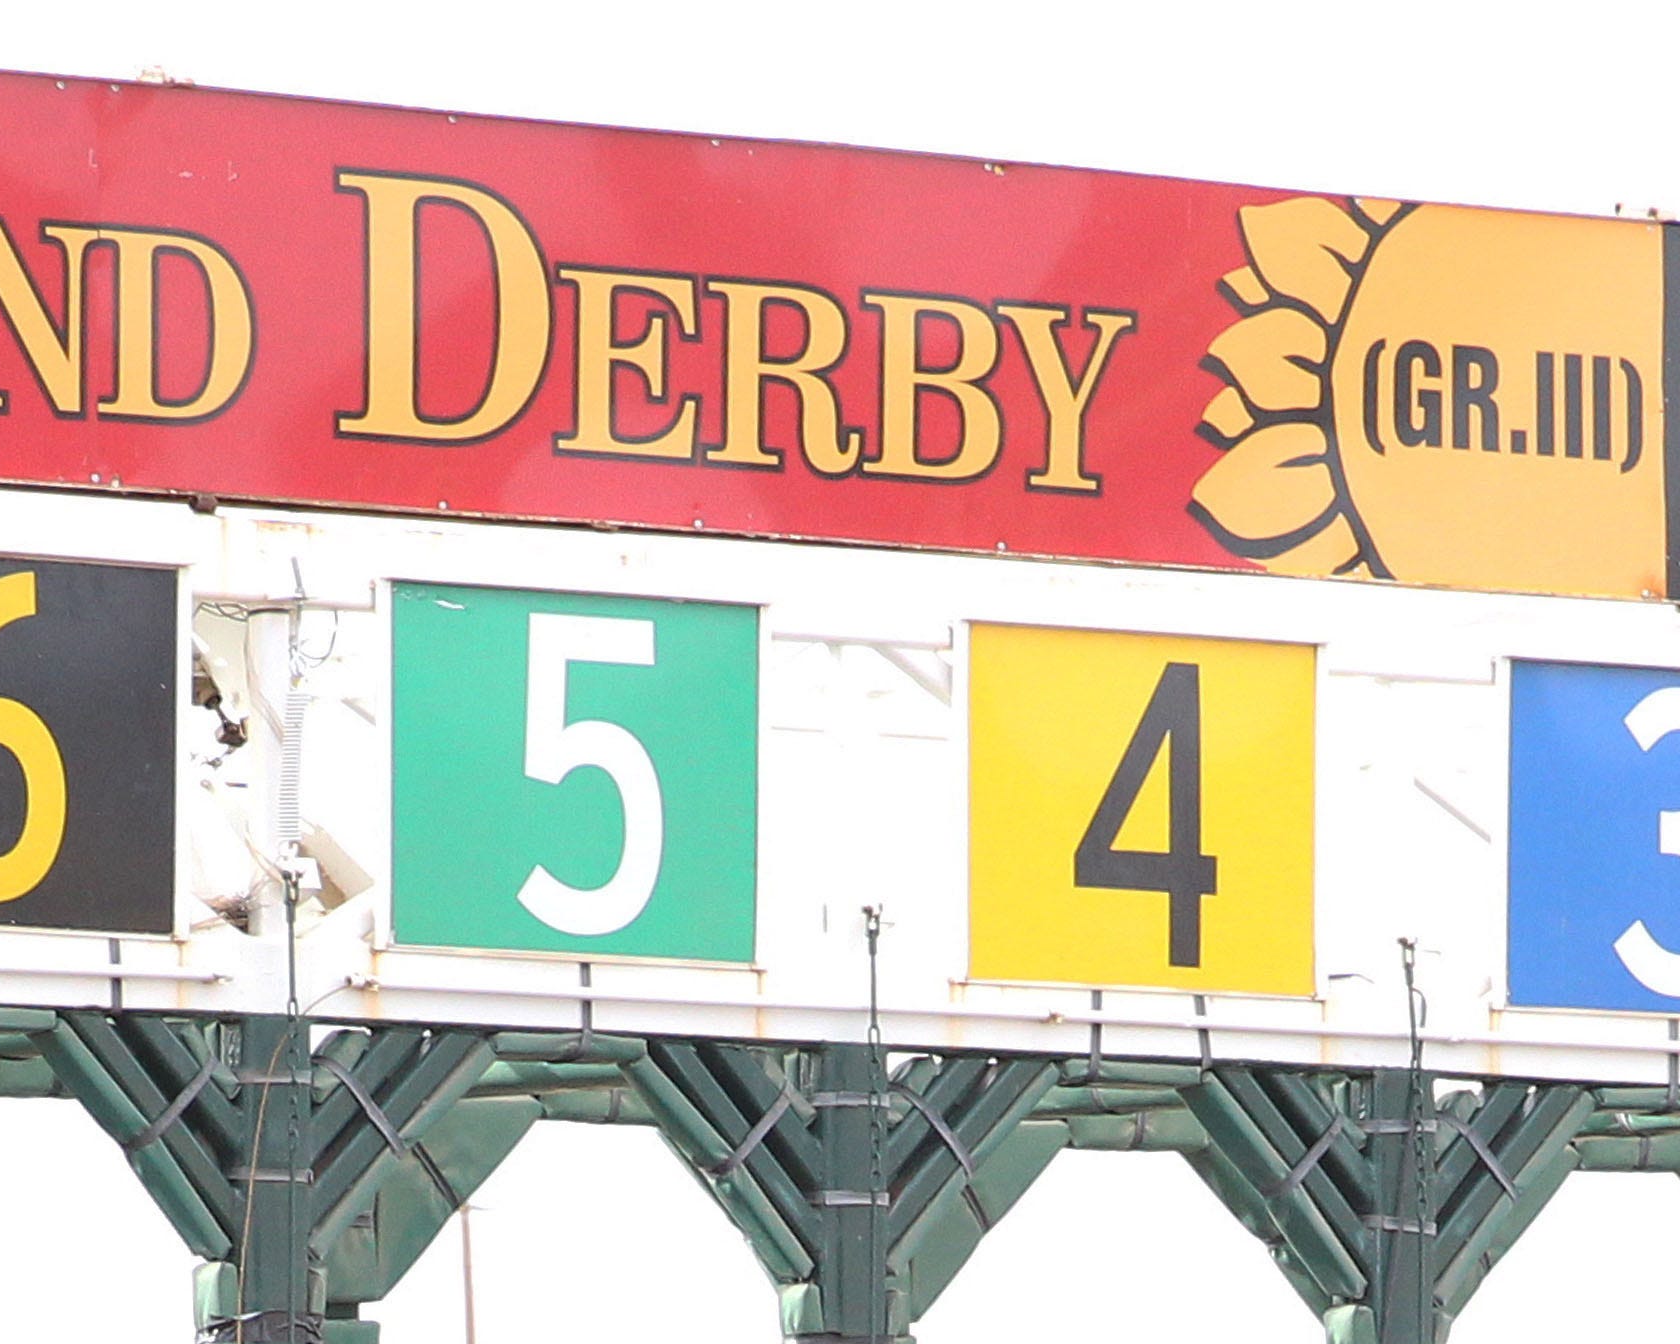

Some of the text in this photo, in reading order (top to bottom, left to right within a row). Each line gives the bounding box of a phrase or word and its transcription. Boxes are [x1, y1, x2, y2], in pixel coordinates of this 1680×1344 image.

[334, 169, 1137, 497] DERBY
[1362, 338, 1645, 472] (GR.III)
[517, 613, 663, 936] 5
[1073, 661, 1218, 969] 4
